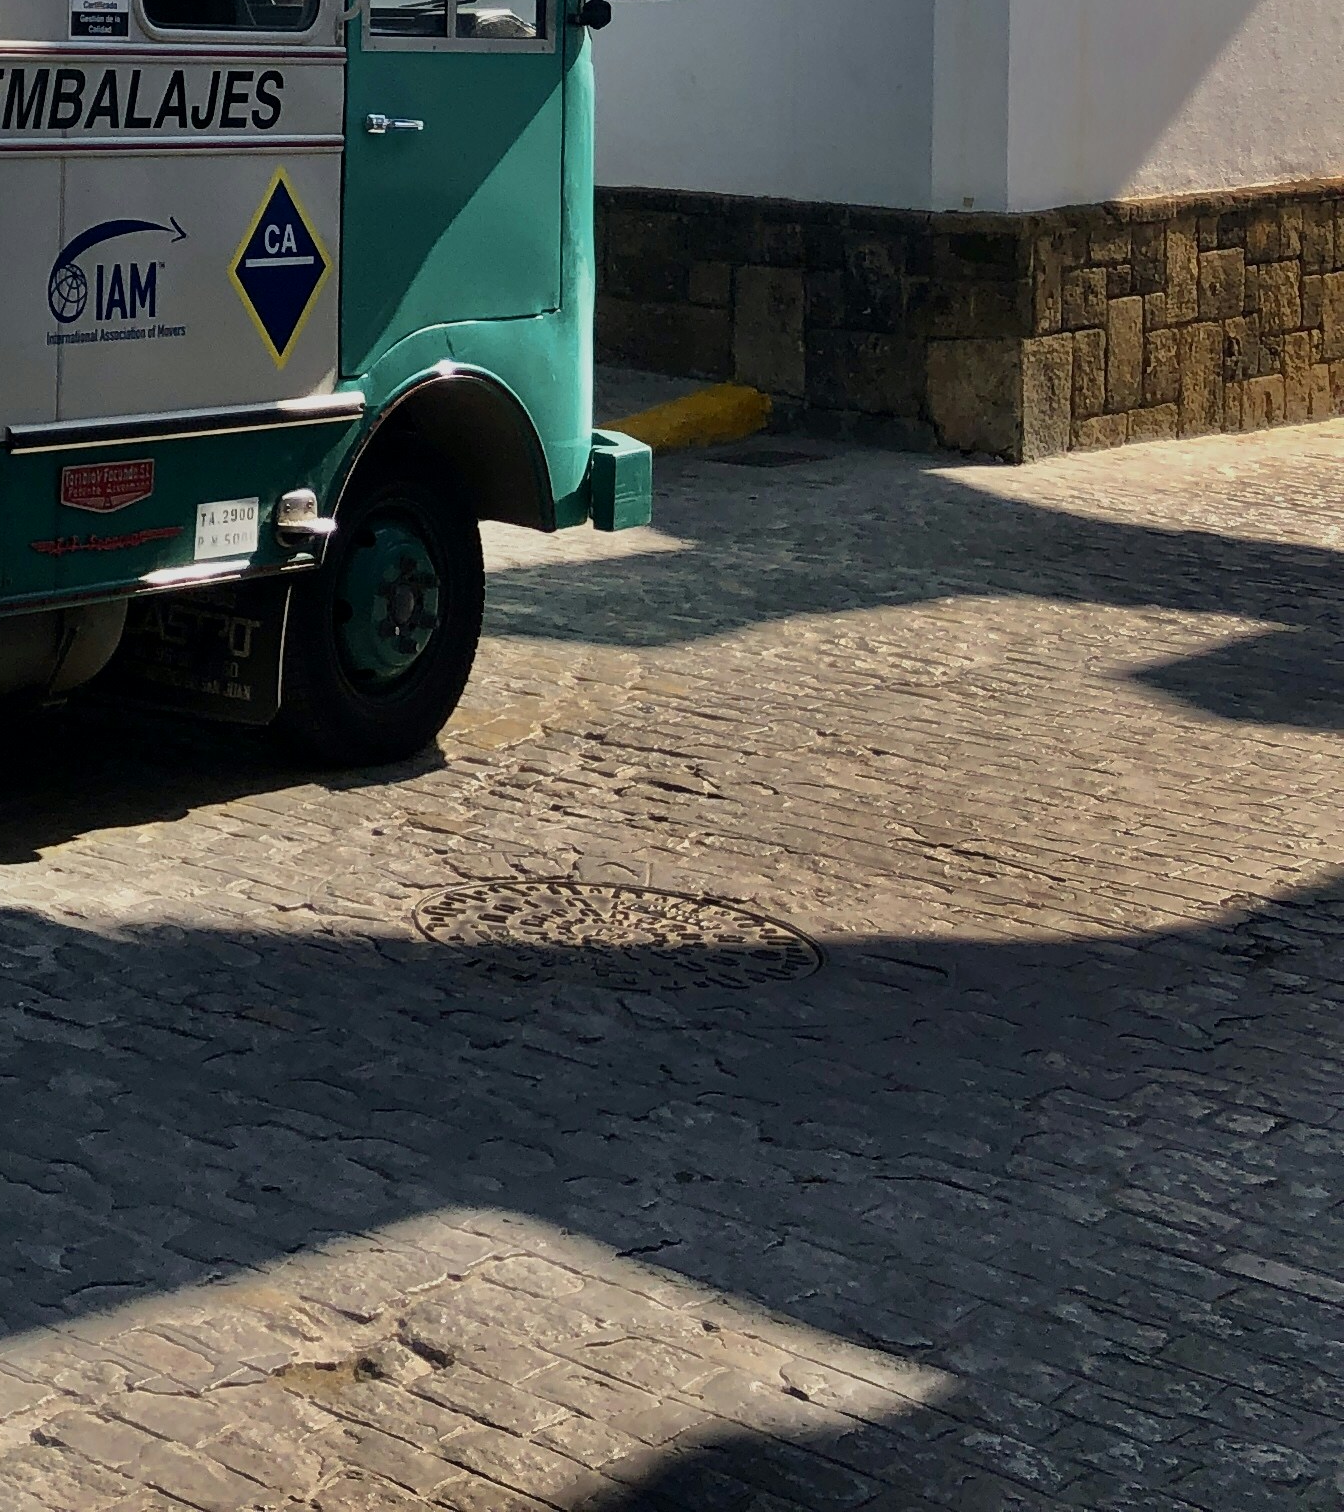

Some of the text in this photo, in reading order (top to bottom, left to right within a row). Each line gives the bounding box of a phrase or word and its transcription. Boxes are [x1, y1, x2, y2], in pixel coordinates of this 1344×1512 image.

[83, 0, 117, 9] Certificado
[264, 223, 297, 254] CA
[95, 261, 157, 321] IAM
[46, 328, 98, 345] International
[99, 327, 146, 342] Association
